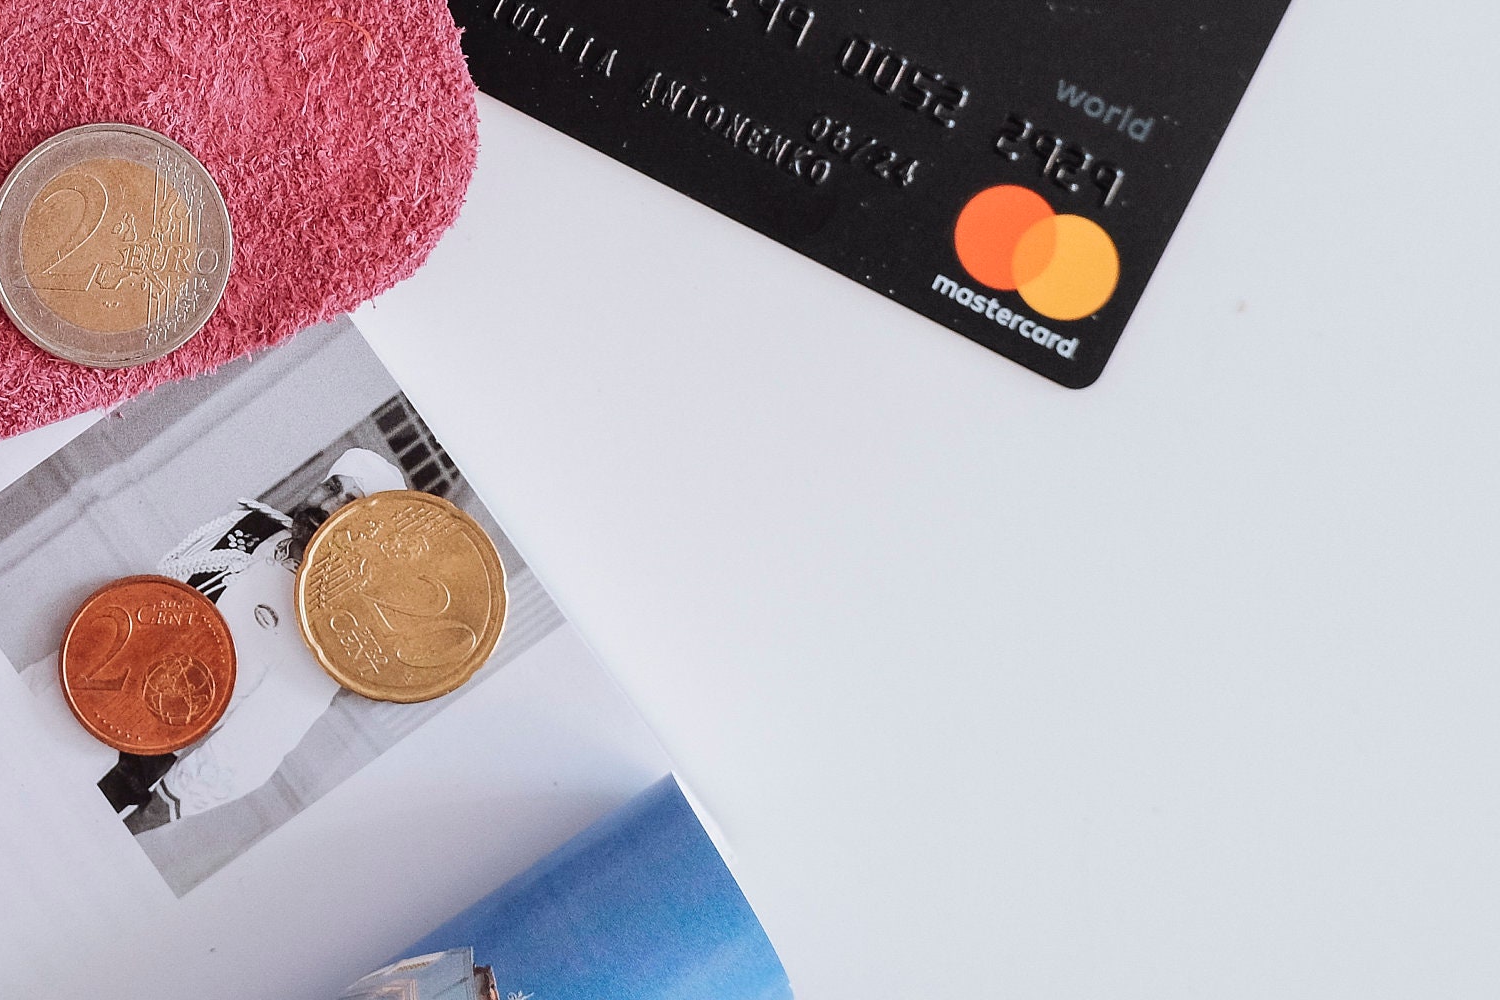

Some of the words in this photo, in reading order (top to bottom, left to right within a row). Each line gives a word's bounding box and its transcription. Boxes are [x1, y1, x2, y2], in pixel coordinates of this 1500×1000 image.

[841, 38, 970, 129] 0052
[996, 114, 1125, 207] 2929
[1056, 79, 1156, 143] world
[14, 172, 109, 292] 2
[121, 245, 219, 275] EURO
[931, 273, 1080, 360] mastercard
[72, 604, 132, 691] 2
